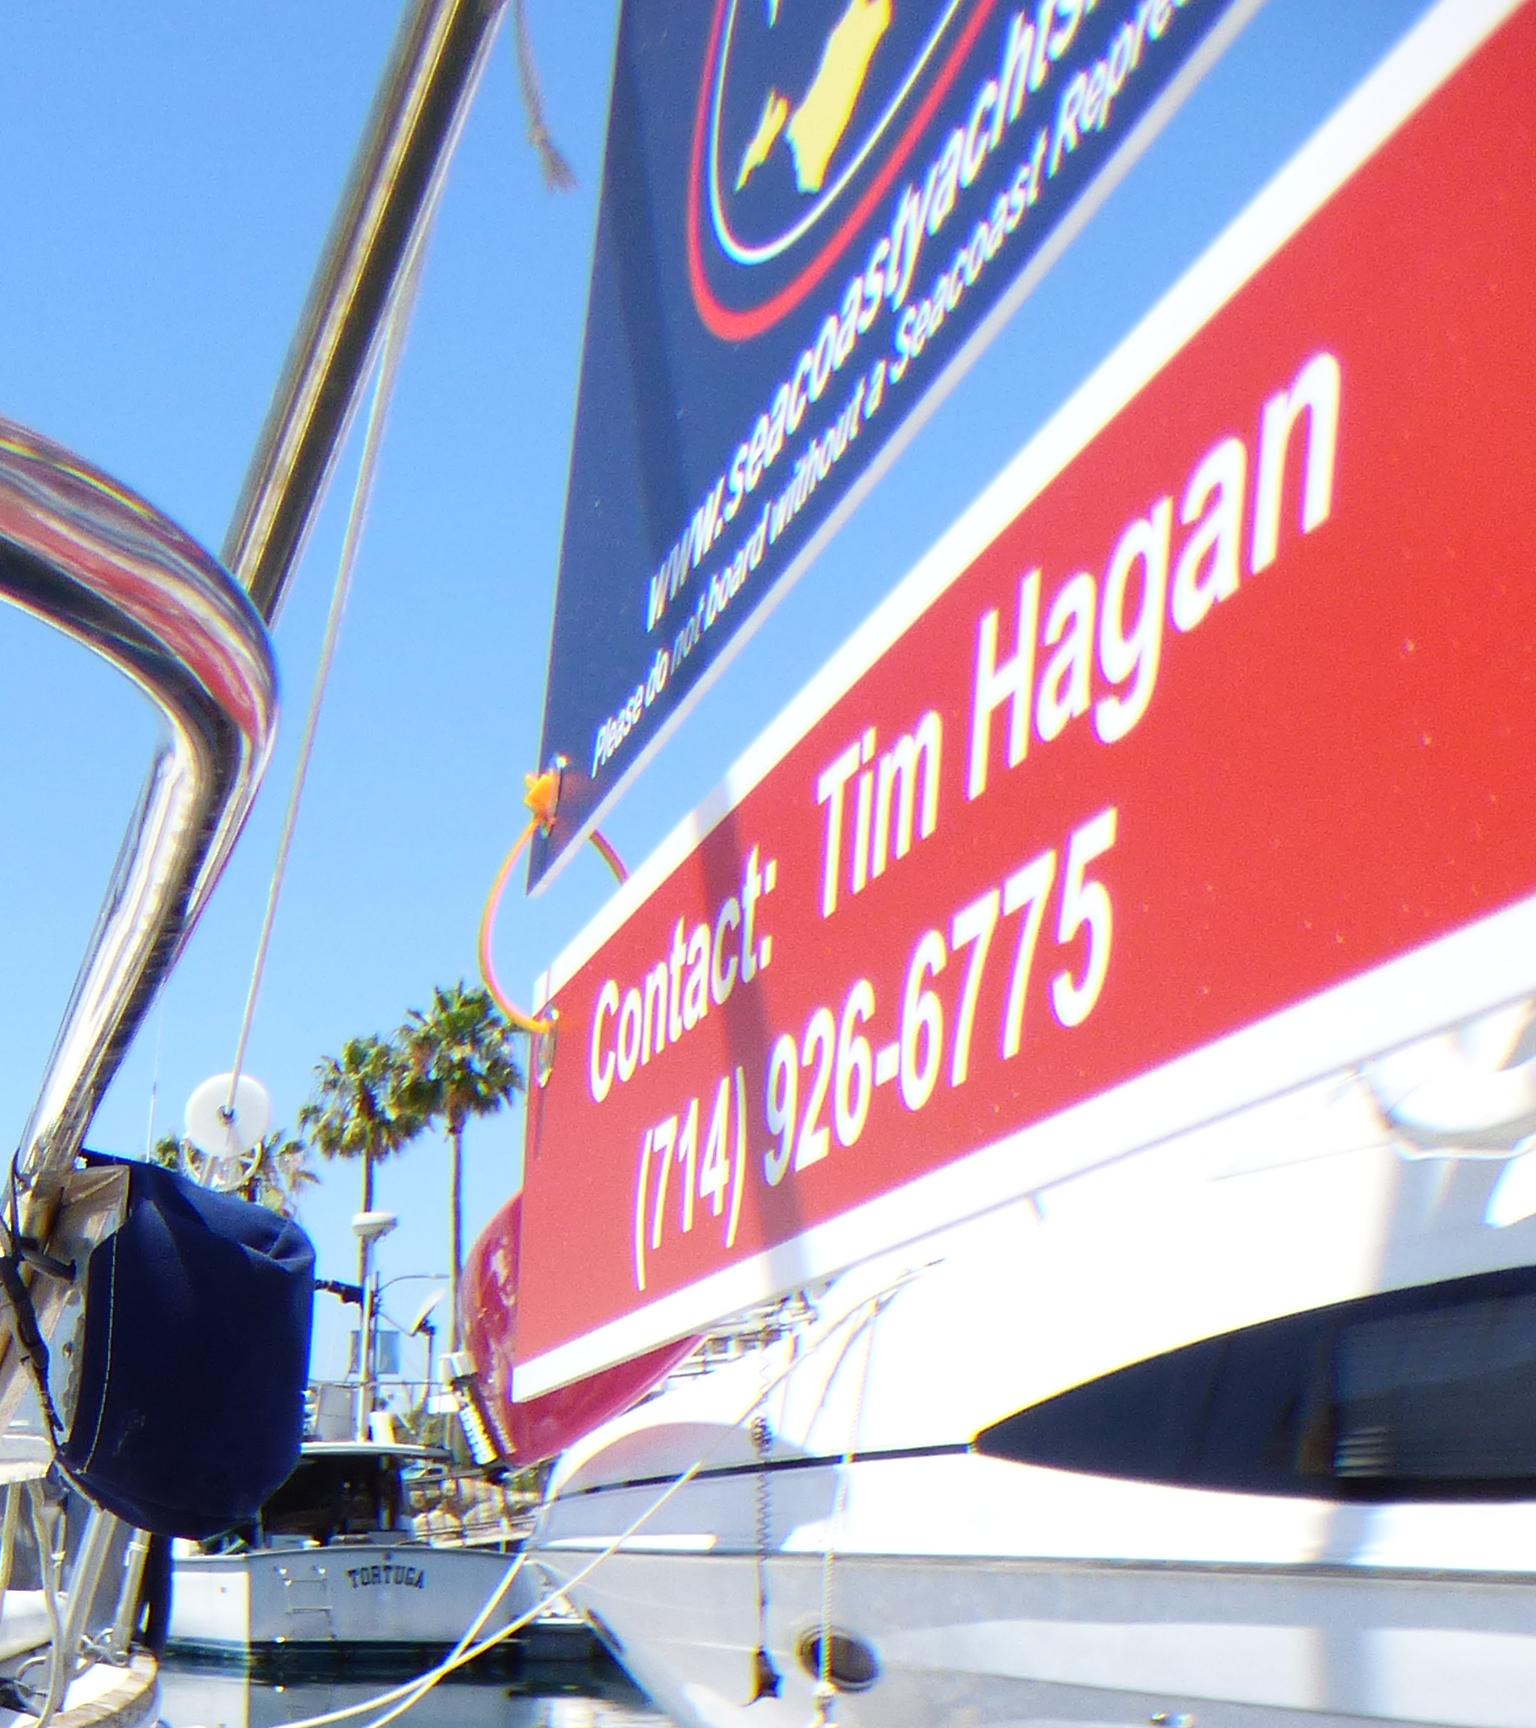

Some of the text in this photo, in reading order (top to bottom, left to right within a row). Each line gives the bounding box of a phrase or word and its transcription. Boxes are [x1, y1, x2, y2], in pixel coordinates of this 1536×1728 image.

[590, 0, 1190, 780] Please do not board without a Seacoast Repre
[588, 351, 1343, 1103] Contact: Tim Hagan
[633, 806, 1119, 1291] (714) 926-6775
[346, 1564, 426, 1589] TORTUGA
